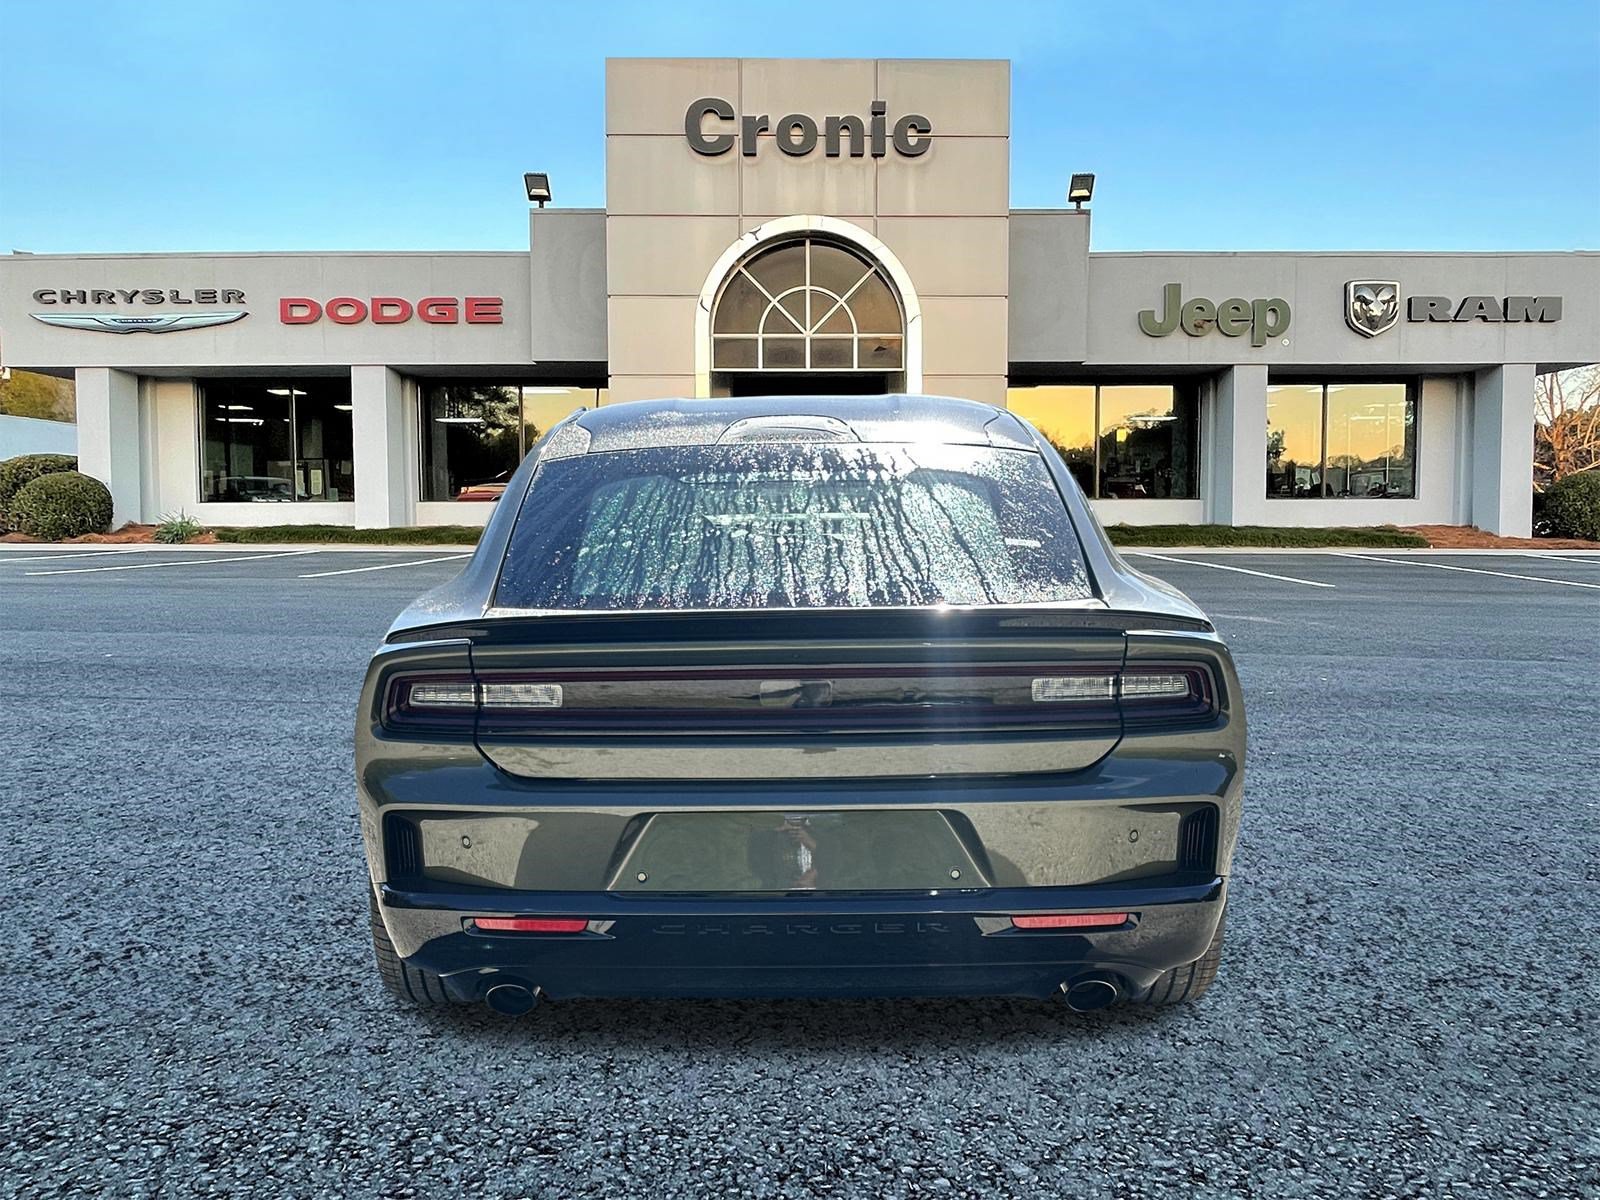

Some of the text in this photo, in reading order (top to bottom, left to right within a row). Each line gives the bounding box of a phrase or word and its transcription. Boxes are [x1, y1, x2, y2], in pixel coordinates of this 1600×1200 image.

[685, 97, 931, 157] Cronic
[32, 289, 246, 305] CHRYSLER
[1407, 296, 1563, 323] RAM
[280, 297, 503, 325] DODGE
[1138, 283, 1291, 347] Jeep
[652, 922, 950, 935] CHARGER
